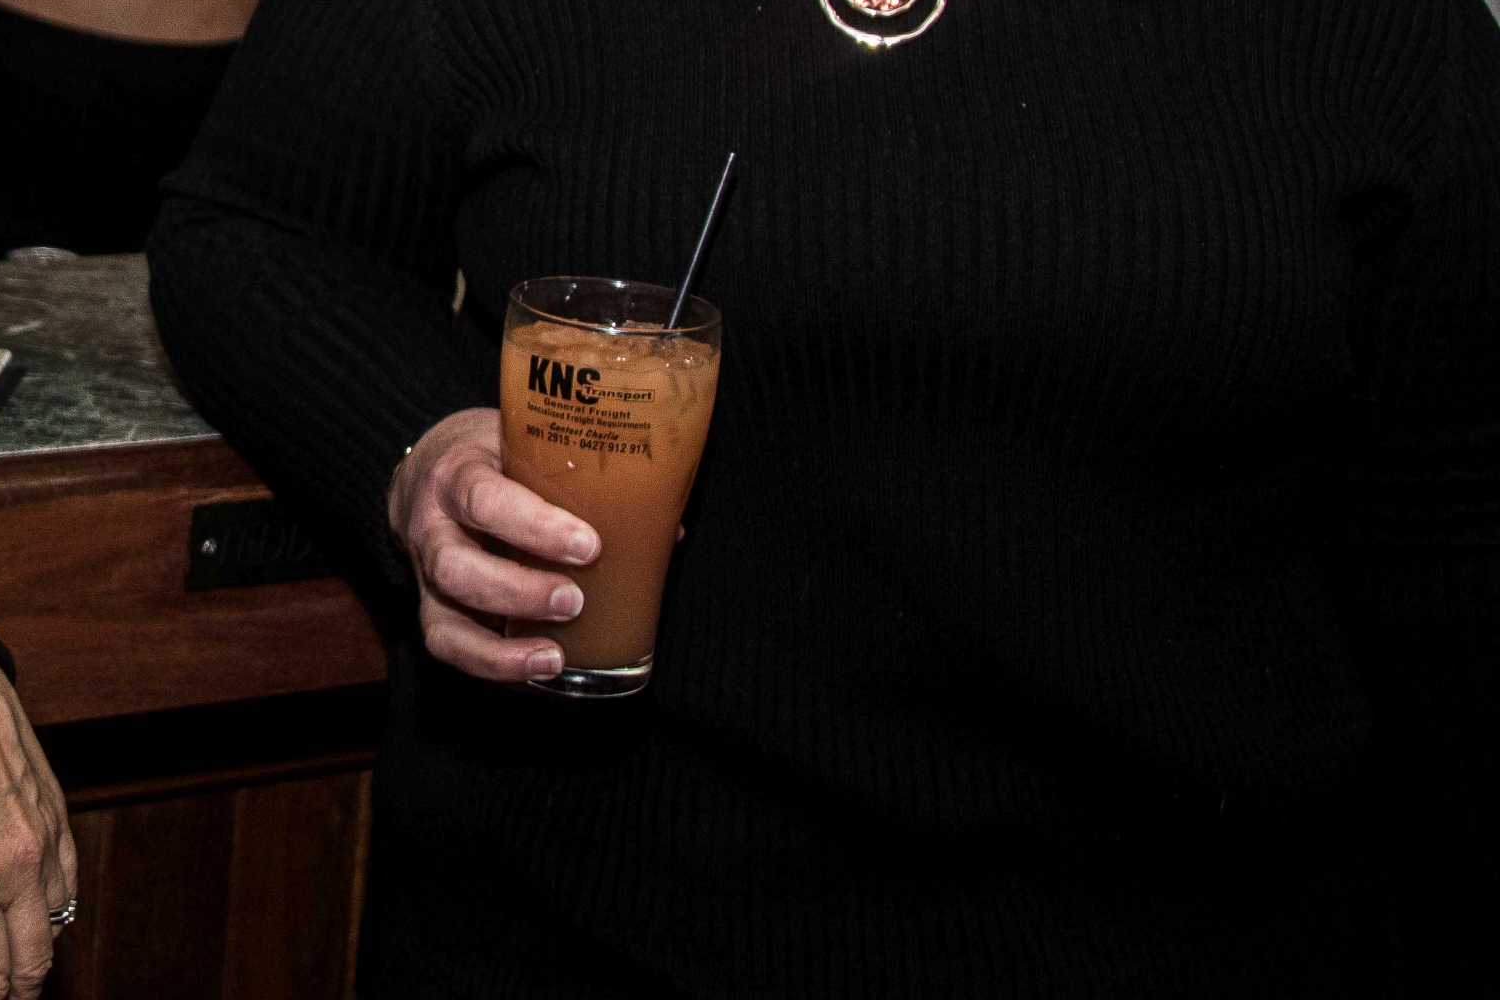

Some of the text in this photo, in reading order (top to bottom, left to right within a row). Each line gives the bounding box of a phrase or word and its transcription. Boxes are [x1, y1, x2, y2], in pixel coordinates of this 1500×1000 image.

[528, 354, 653, 405] KNS Transport
[544, 397, 630, 420] General Freight
